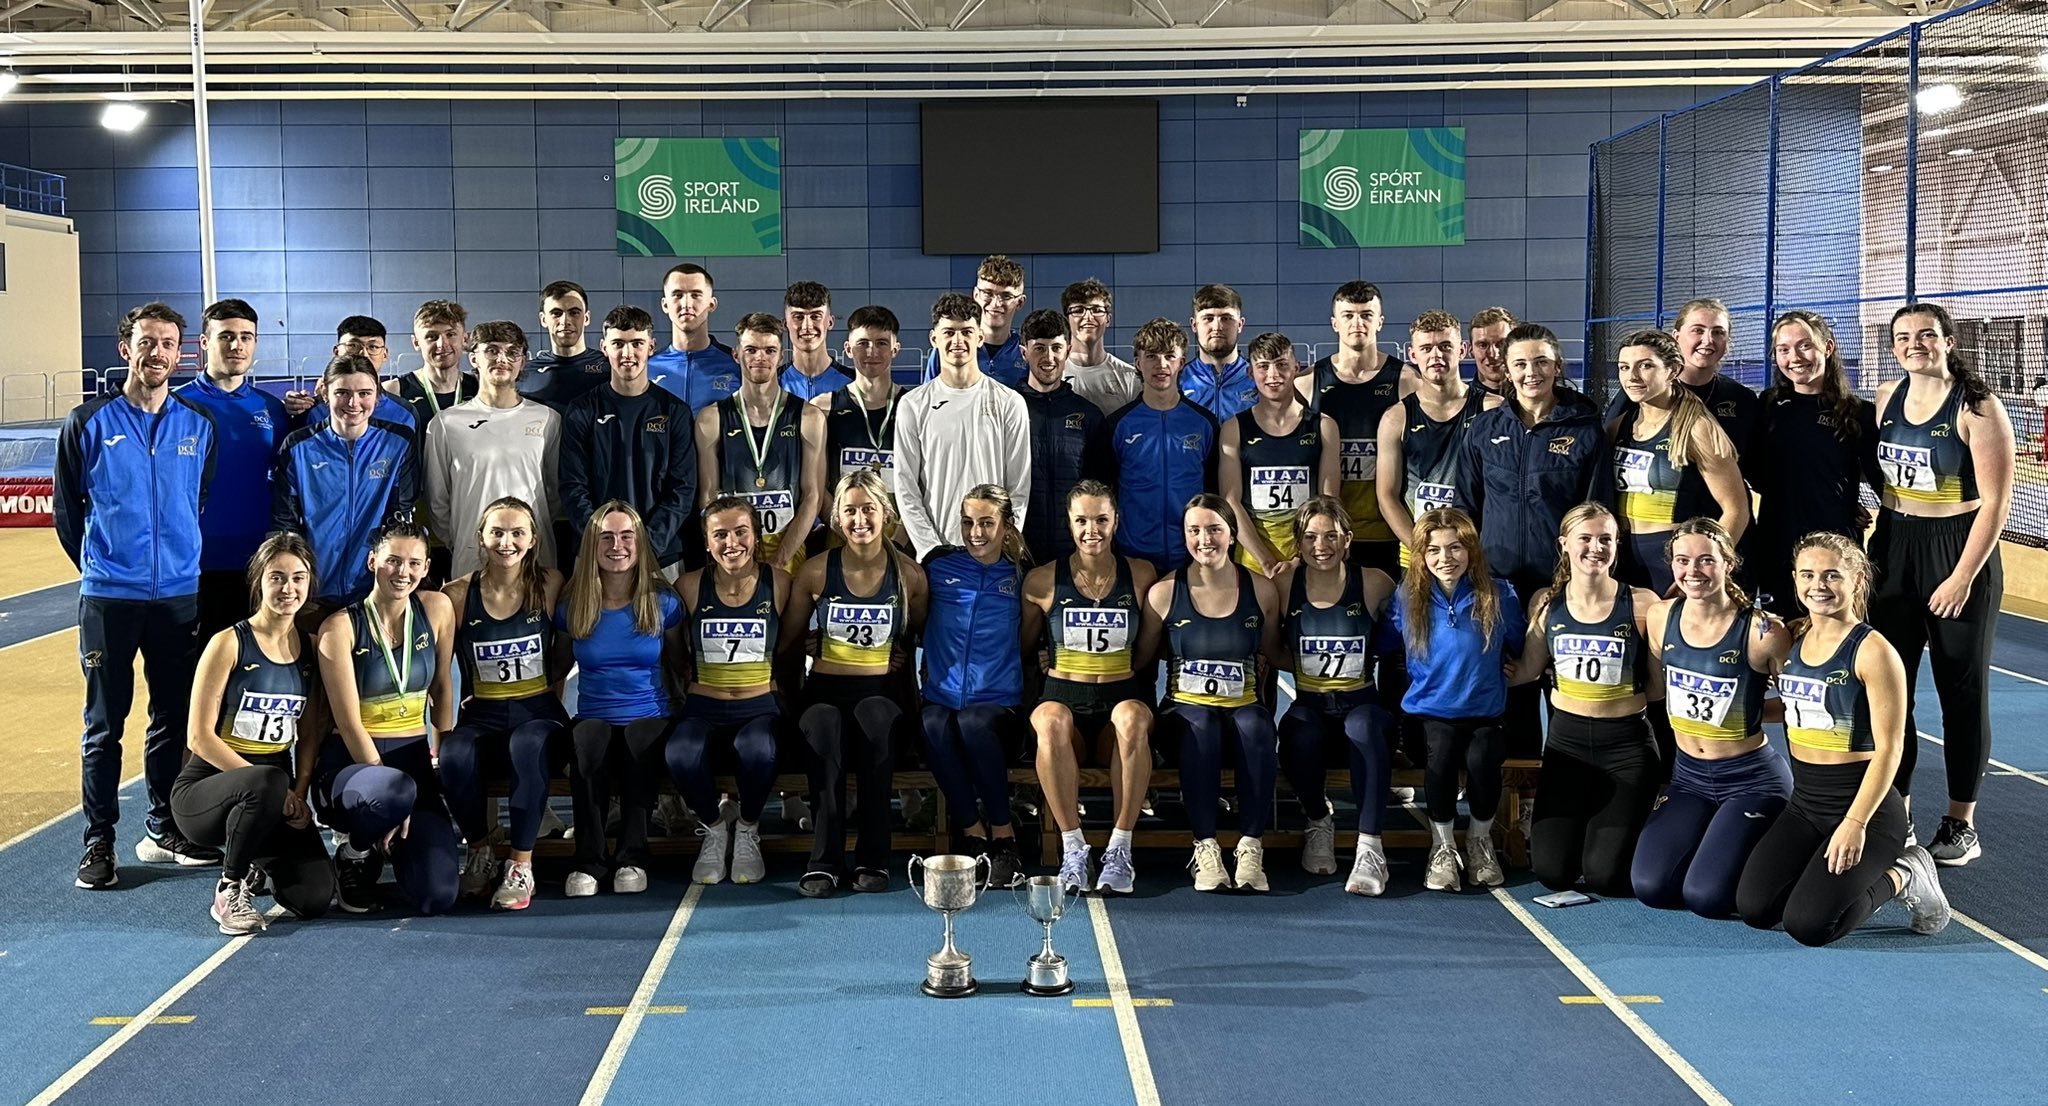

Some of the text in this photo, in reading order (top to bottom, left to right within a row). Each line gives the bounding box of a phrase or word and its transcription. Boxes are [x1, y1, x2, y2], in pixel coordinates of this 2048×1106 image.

[1369, 169, 1422, 186] SPÓRT
[684, 182, 740, 197] SPORT
[1370, 188, 1441, 204] ÉIREANN
[685, 199, 760, 213] IRELAND
[254, 415, 269, 423] DCU
[647, 422, 665, 430] DCU
[178, 444, 196, 452] DCU
[1550, 442, 1569, 451] DCU
[1880, 445, 1926, 463] IUAA
[845, 452, 894, 463] IUAA
[1254, 470, 1305, 480] IUAA
[1897, 463, 1916, 488] 19
[1269, 485, 1293, 508] 54
[833, 608, 888, 619] IUAA
[1073, 612, 1123, 623] IUAA
[706, 624, 763, 633] IUAA
[846, 625, 873, 646] 23
[416, 642, 429, 650] DCU
[1089, 629, 1110, 652] 15
[1305, 640, 1361, 650] IUAA
[1563, 639, 1617, 653] IUAA
[479, 641, 538, 656] IUAA
[727, 639, 741, 662] 7
[497, 659, 522, 681] 31
[1319, 653, 1346, 678] 27
[1576, 657, 1599, 681] 10
[1205, 679, 1218, 694] 9
[1672, 672, 1736, 693] IUAA
[1779, 680, 1822, 697] IUAA
[1826, 677, 1847, 685] DCU
[247, 697, 303, 713] IUAA
[1687, 694, 1714, 721] 33
[1794, 700, 1801, 727] 1
[259, 714, 284, 742] 13
